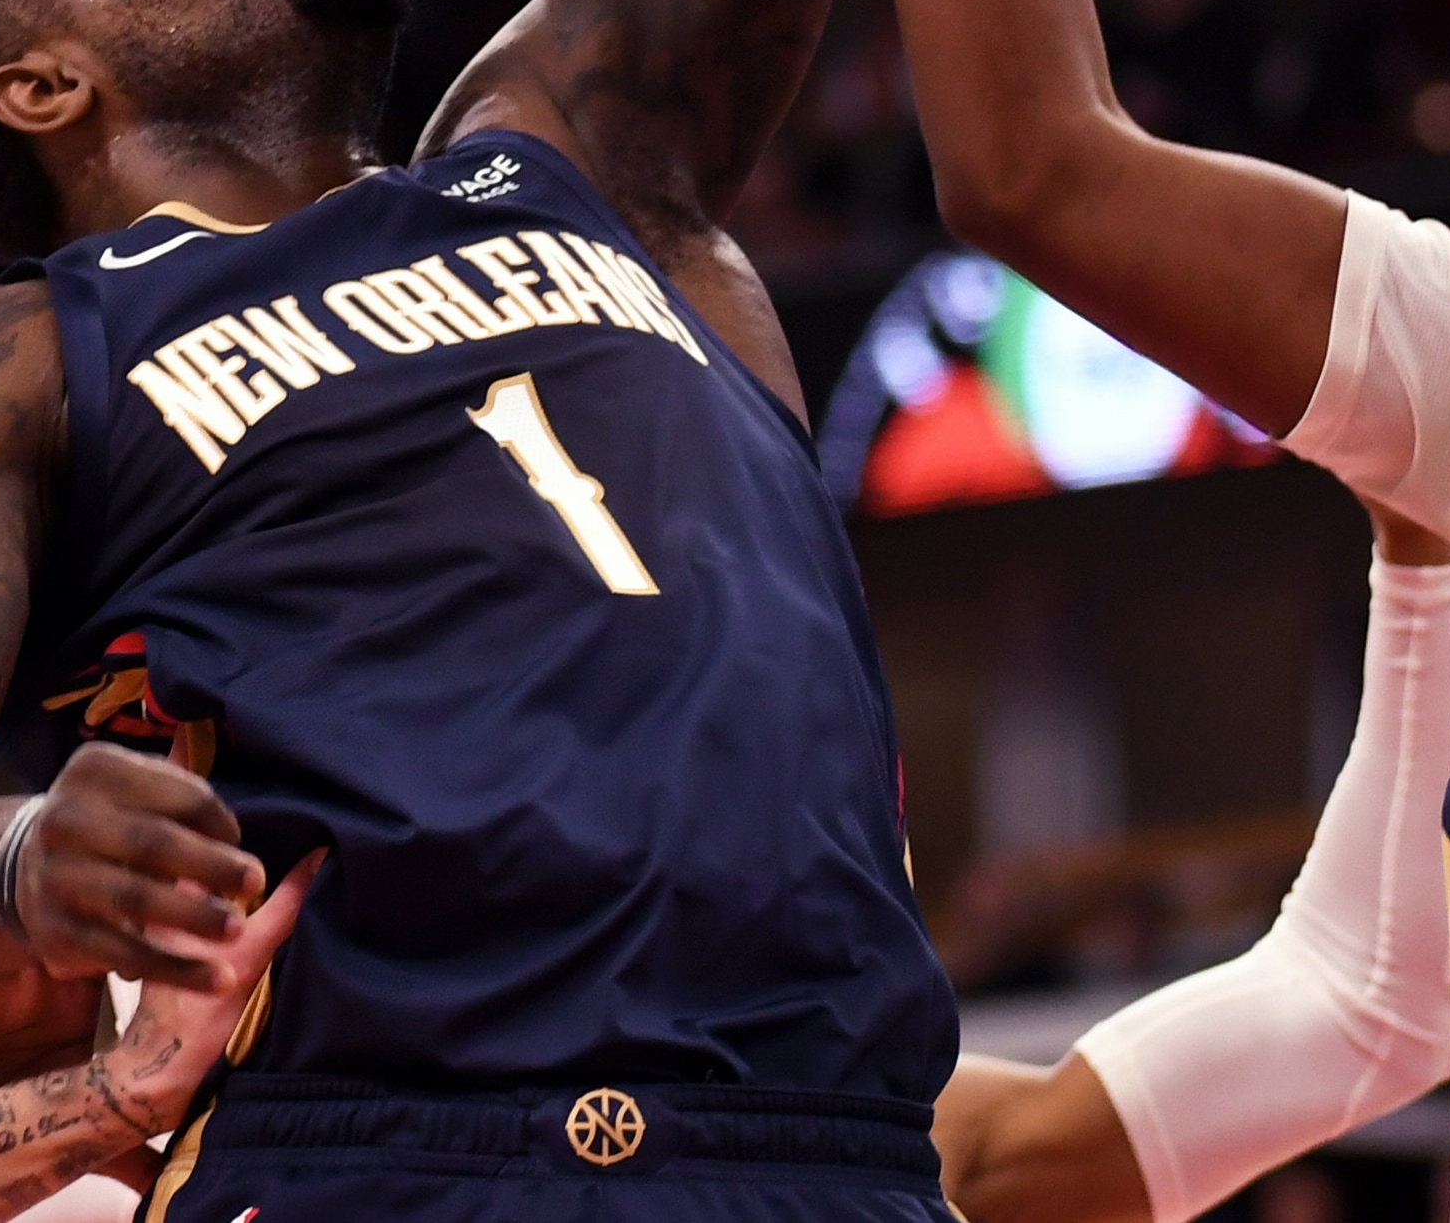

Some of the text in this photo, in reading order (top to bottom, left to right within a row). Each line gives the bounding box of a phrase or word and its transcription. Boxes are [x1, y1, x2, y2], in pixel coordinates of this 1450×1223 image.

[127, 230, 709, 475] NEW ORLEANS
[465, 370, 661, 597] 1
